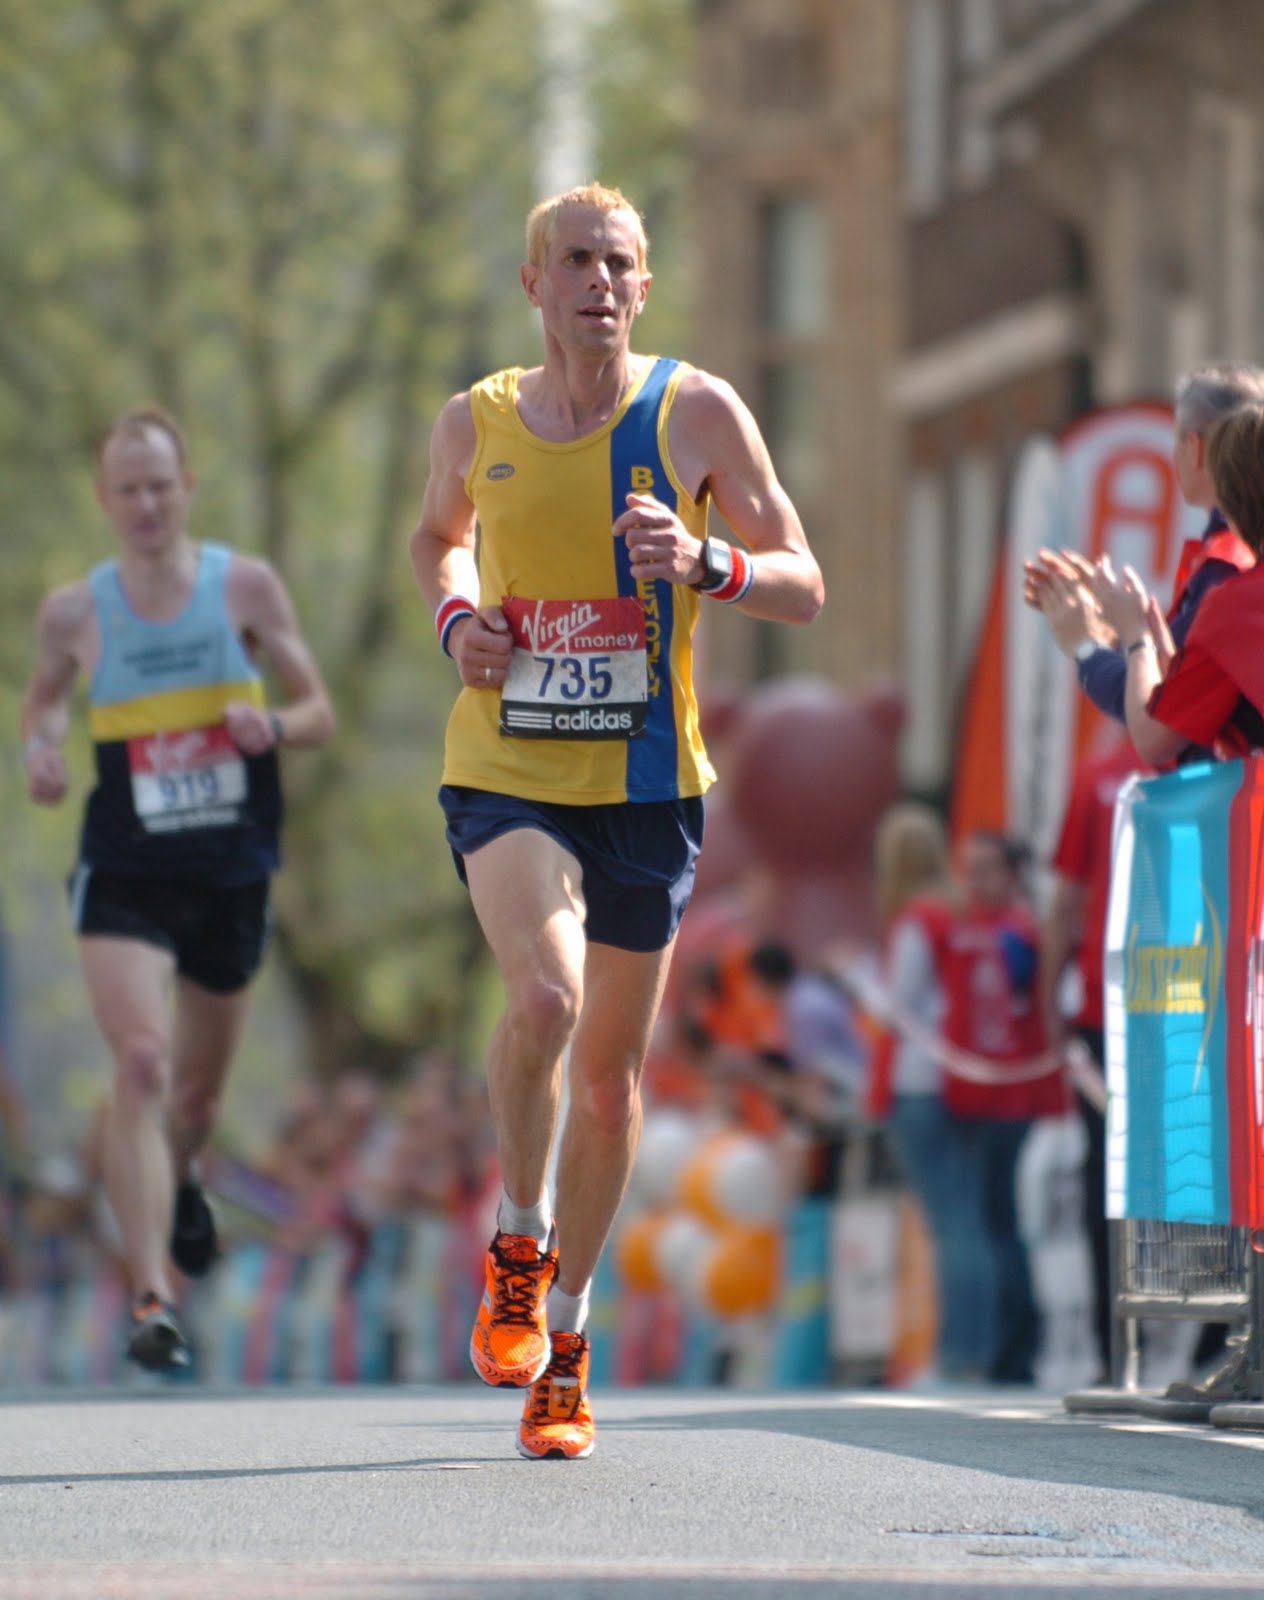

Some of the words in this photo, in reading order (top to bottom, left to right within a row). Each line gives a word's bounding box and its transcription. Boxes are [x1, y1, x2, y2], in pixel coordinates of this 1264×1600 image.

[521, 600, 601, 653] Virgin
[574, 631, 638, 651] money
[533, 656, 613, 700] 735
[554, 709, 632, 731] adidas
